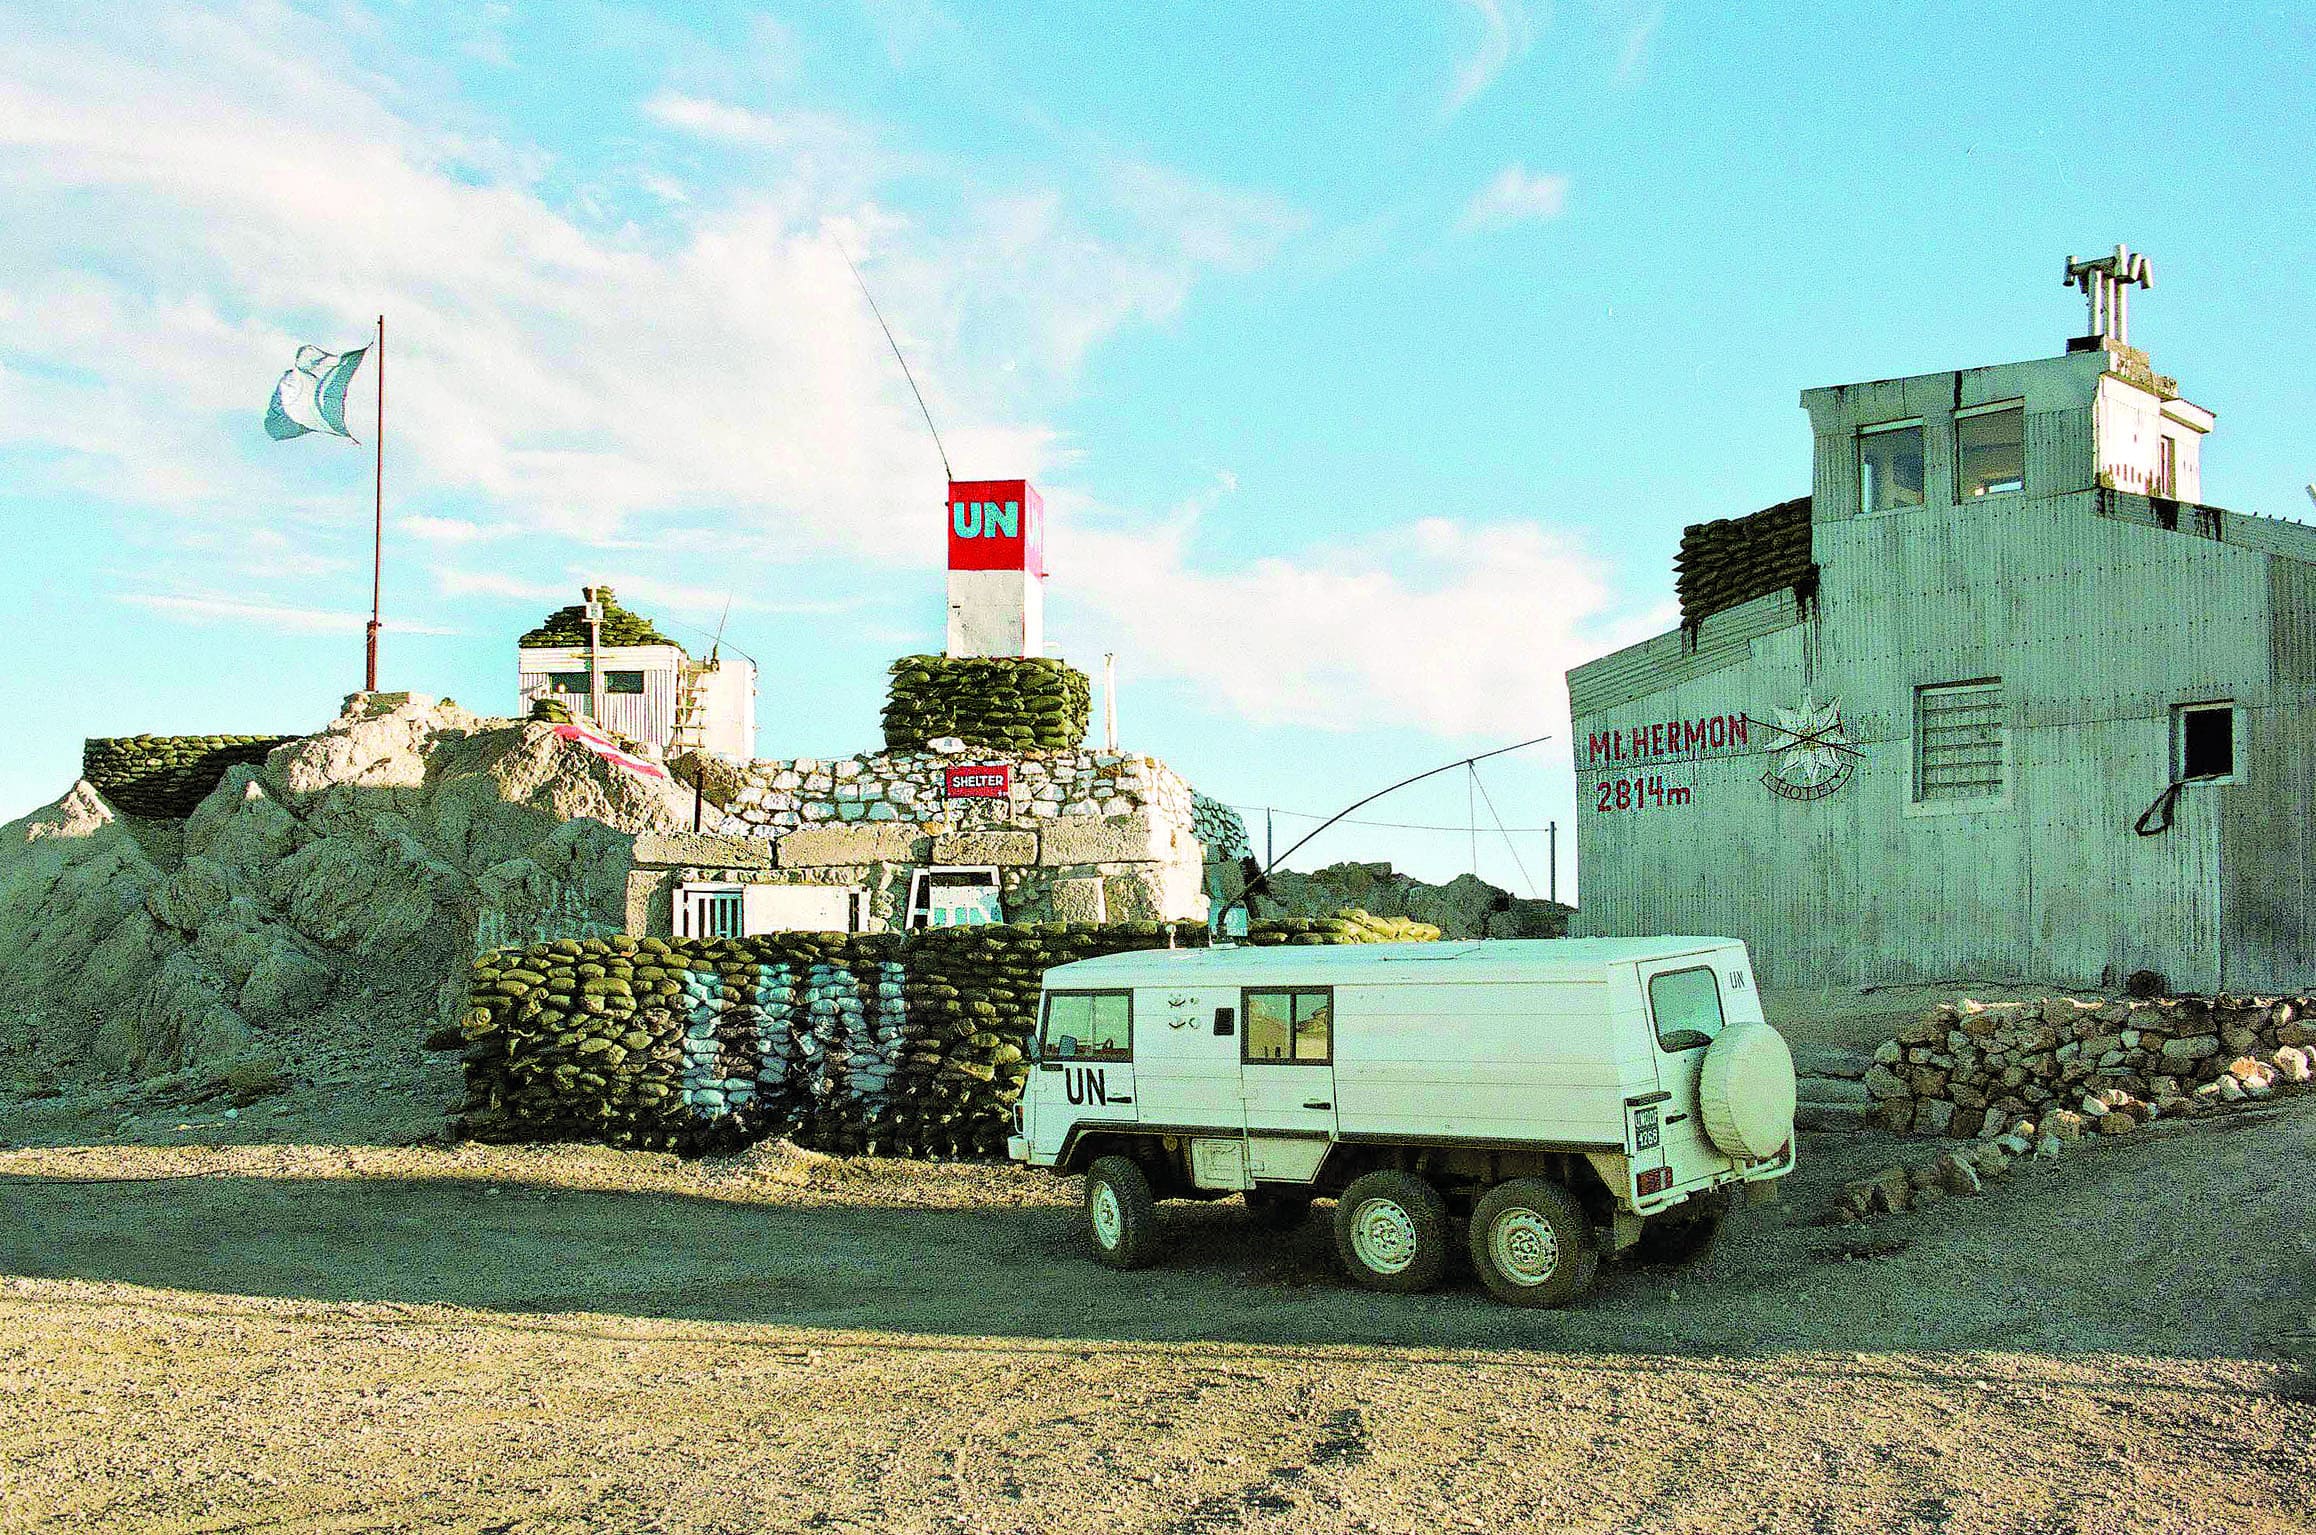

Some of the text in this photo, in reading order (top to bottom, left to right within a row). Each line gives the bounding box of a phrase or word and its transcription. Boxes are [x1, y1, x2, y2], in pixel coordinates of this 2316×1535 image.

[954, 501, 1018, 538] UN
[952, 774, 1004, 788] SHELTER
[1597, 776, 1691, 812] 2814m
[1729, 970, 1745, 989] UN
[1065, 1068, 1106, 1106] UN
